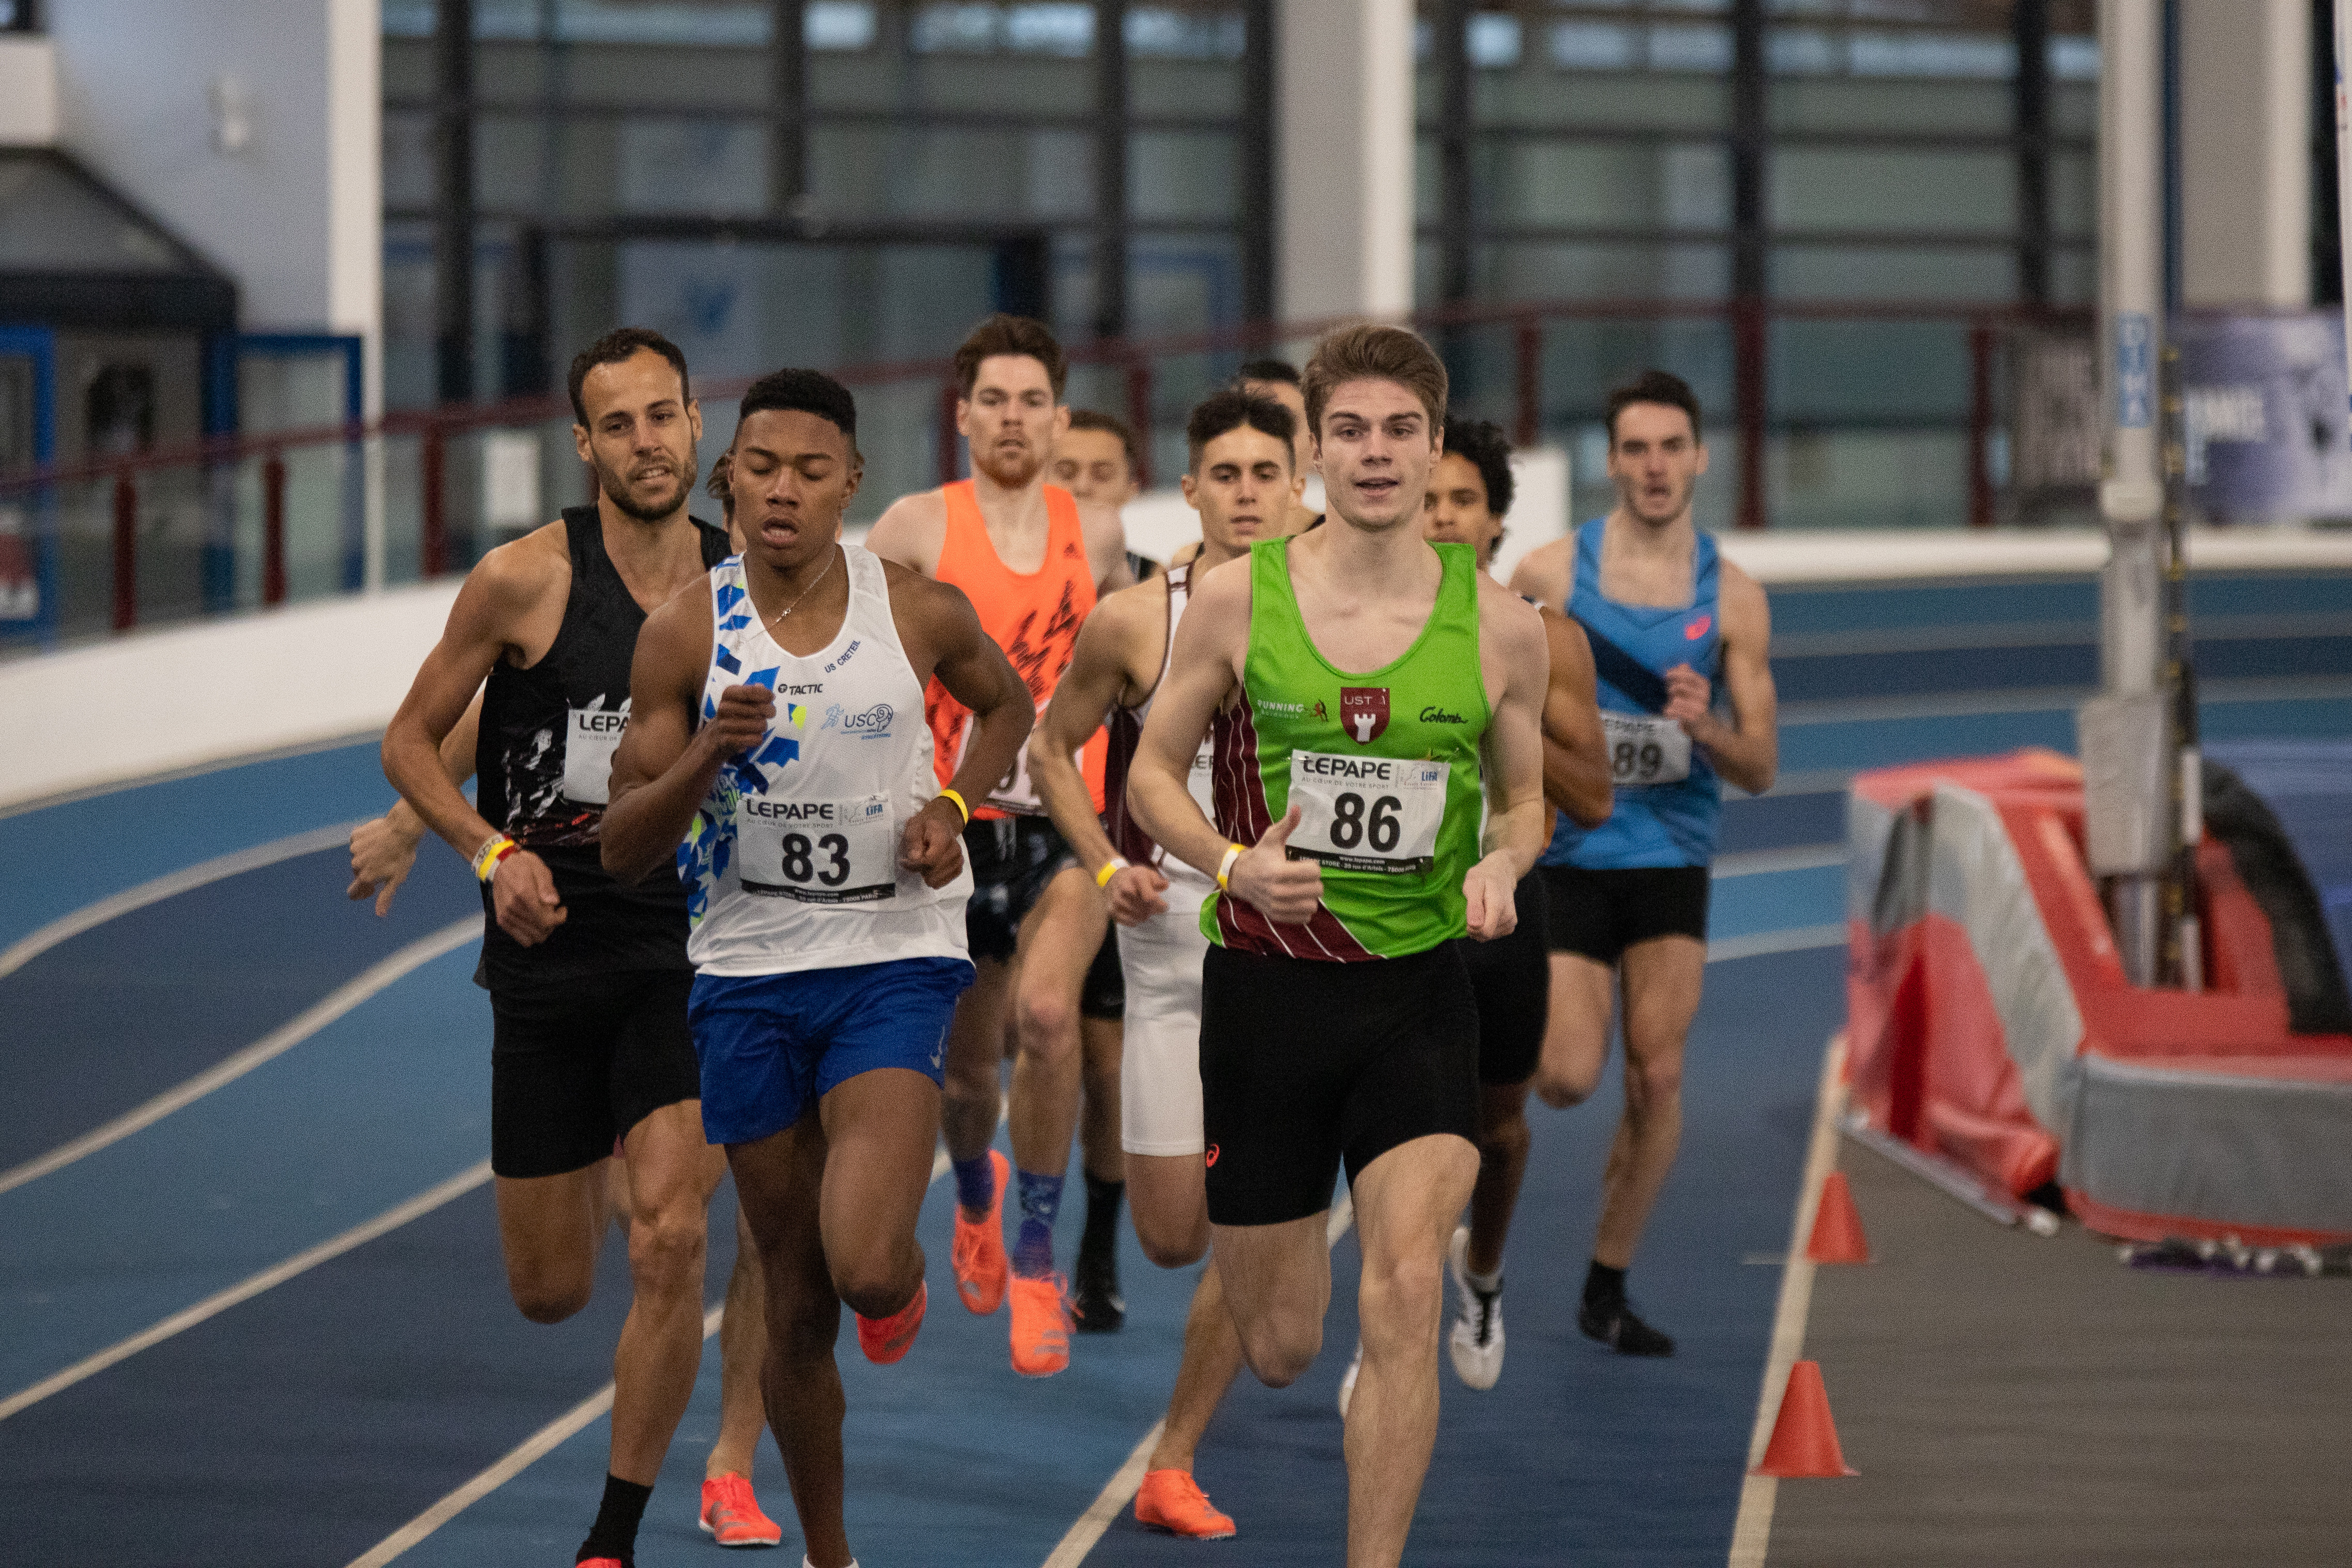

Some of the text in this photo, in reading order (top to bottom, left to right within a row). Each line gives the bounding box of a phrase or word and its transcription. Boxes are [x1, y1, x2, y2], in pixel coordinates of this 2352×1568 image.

[824, 640, 860, 673] US CRETEIL
[789, 683, 823, 695] TACTIC
[1344, 695, 1373, 705] UST
[1303, 756, 1391, 780] LEPAPE
[1613, 741, 1662, 778] 89
[747, 799, 833, 820] LEPAPE
[1329, 792, 1403, 852] 86
[782, 833, 851, 886] 83
